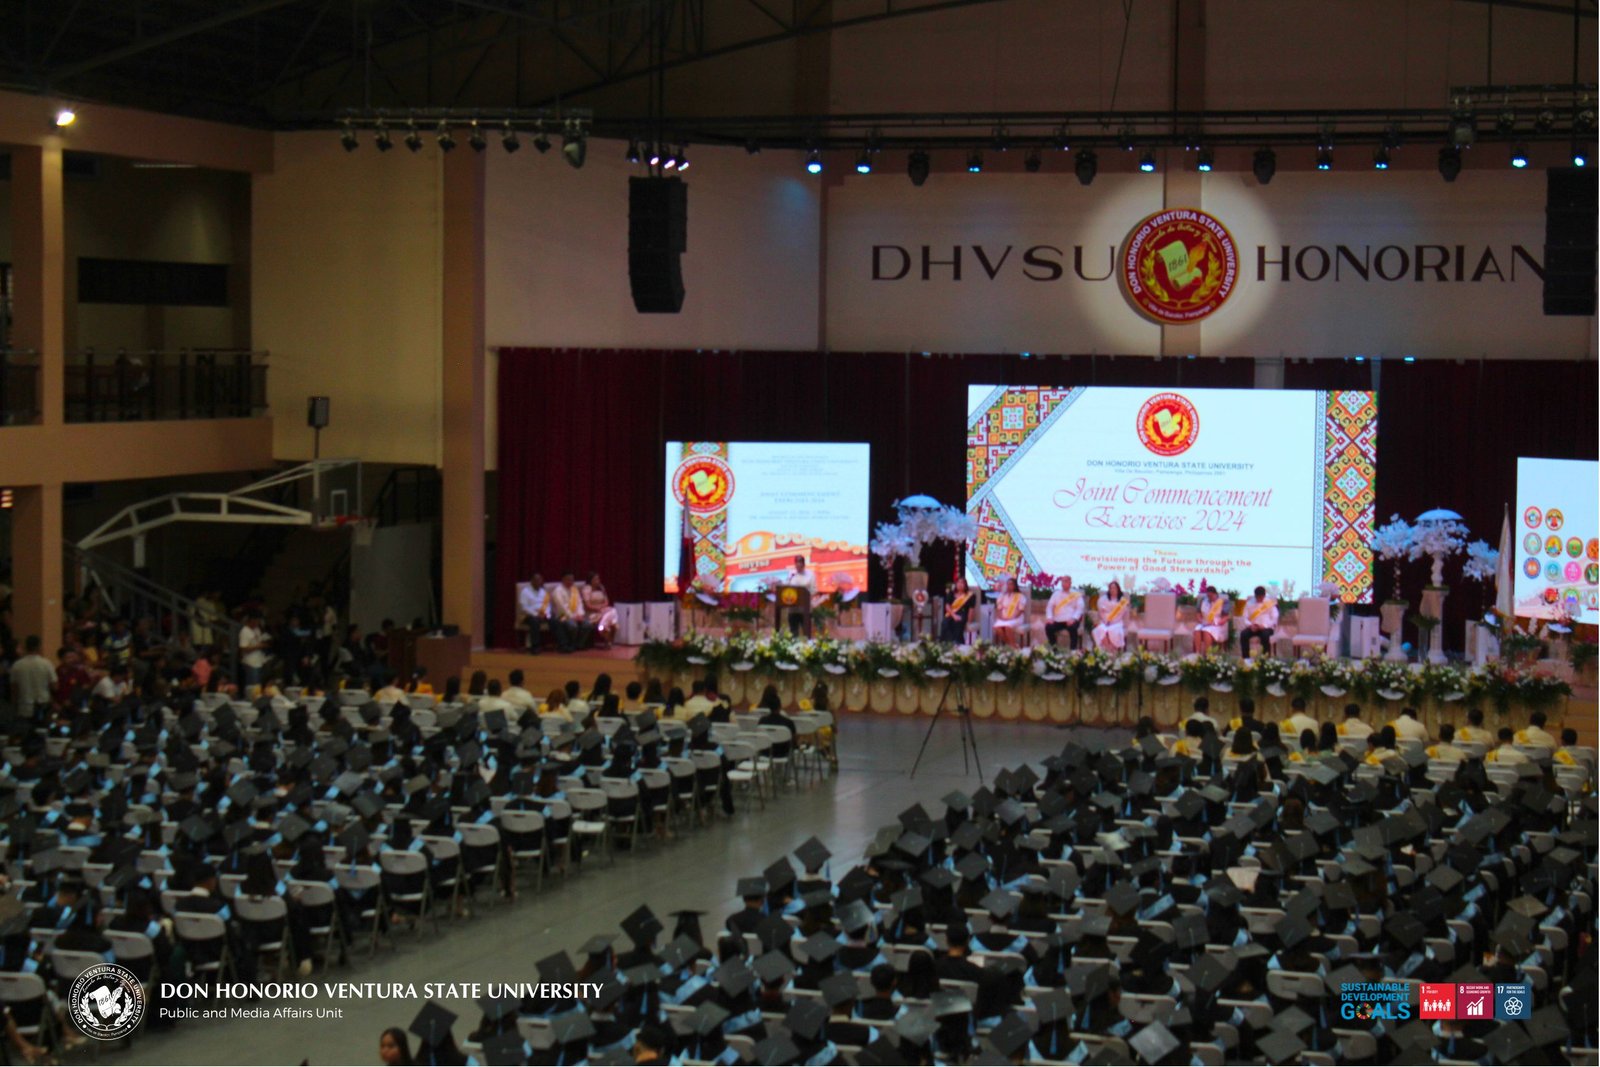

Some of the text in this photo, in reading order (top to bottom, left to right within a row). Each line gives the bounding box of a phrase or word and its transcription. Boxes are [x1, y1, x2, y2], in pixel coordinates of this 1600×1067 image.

[1150, 211, 1197, 227] VENTURA
[1198, 215, 1226, 238] STATE
[1127, 225, 1151, 269] HONORIO
[871, 244, 1115, 282] DHVSU
[1219, 238, 1236, 298] UNIVERSITY
[1128, 271, 1142, 294] DON
[1143, 461, 1179, 469] VENTURA
[1208, 462, 1255, 470] UNIVERSITY
[1052, 477, 1273, 508] Joint Commencement
[1085, 506, 1247, 532] Exercises 2024
[1142, 556, 1157, 564] the
[1161, 557, 1192, 565] Future
[1196, 558, 1233, 568] through
[1236, 559, 1252, 567] the
